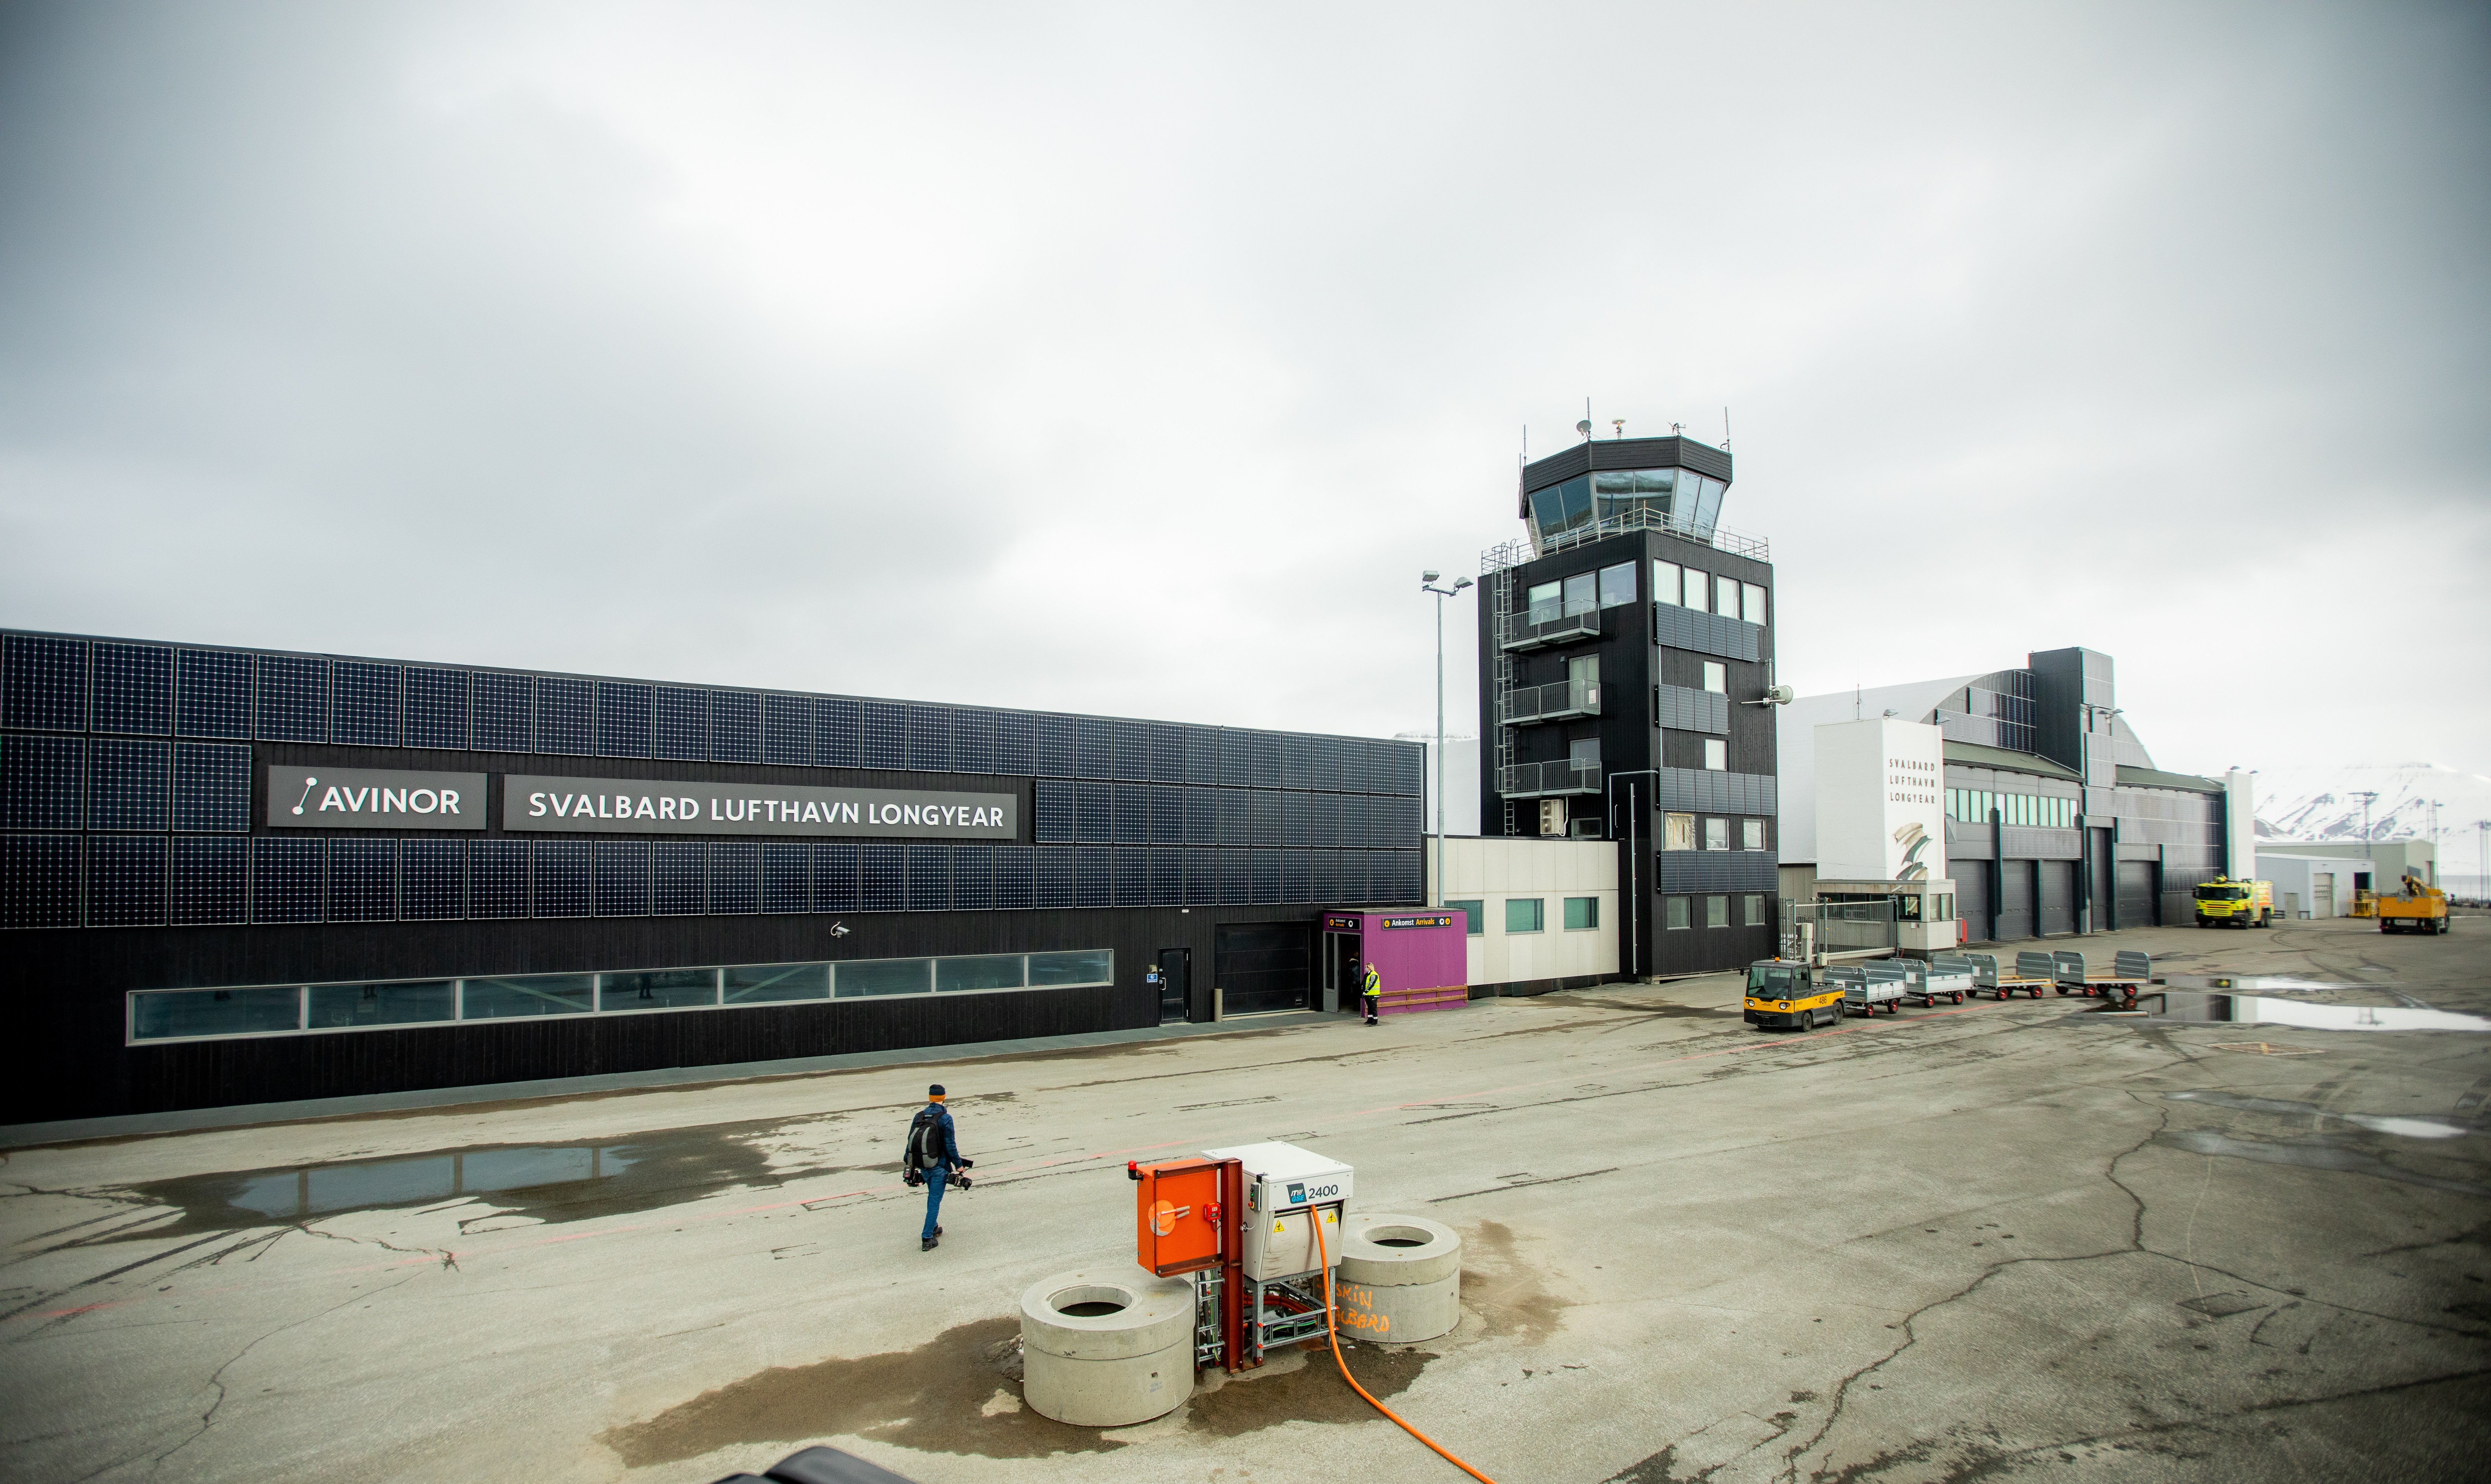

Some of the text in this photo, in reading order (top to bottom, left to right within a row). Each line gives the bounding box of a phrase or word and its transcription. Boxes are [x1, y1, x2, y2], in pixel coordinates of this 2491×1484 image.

[1889, 759, 1935, 771] SVALBARD
[1890, 775, 1935, 788] LUFTHAVN
[319, 786, 461, 814] AVINOR
[1890, 792, 1935, 804] LONGYEAR
[529, 792, 1003, 827] SVALBARD LUFTHAVN LONGYEAR
[1308, 1184, 1338, 1199] 2400
[1291, 1194, 1305, 1203] GSE
